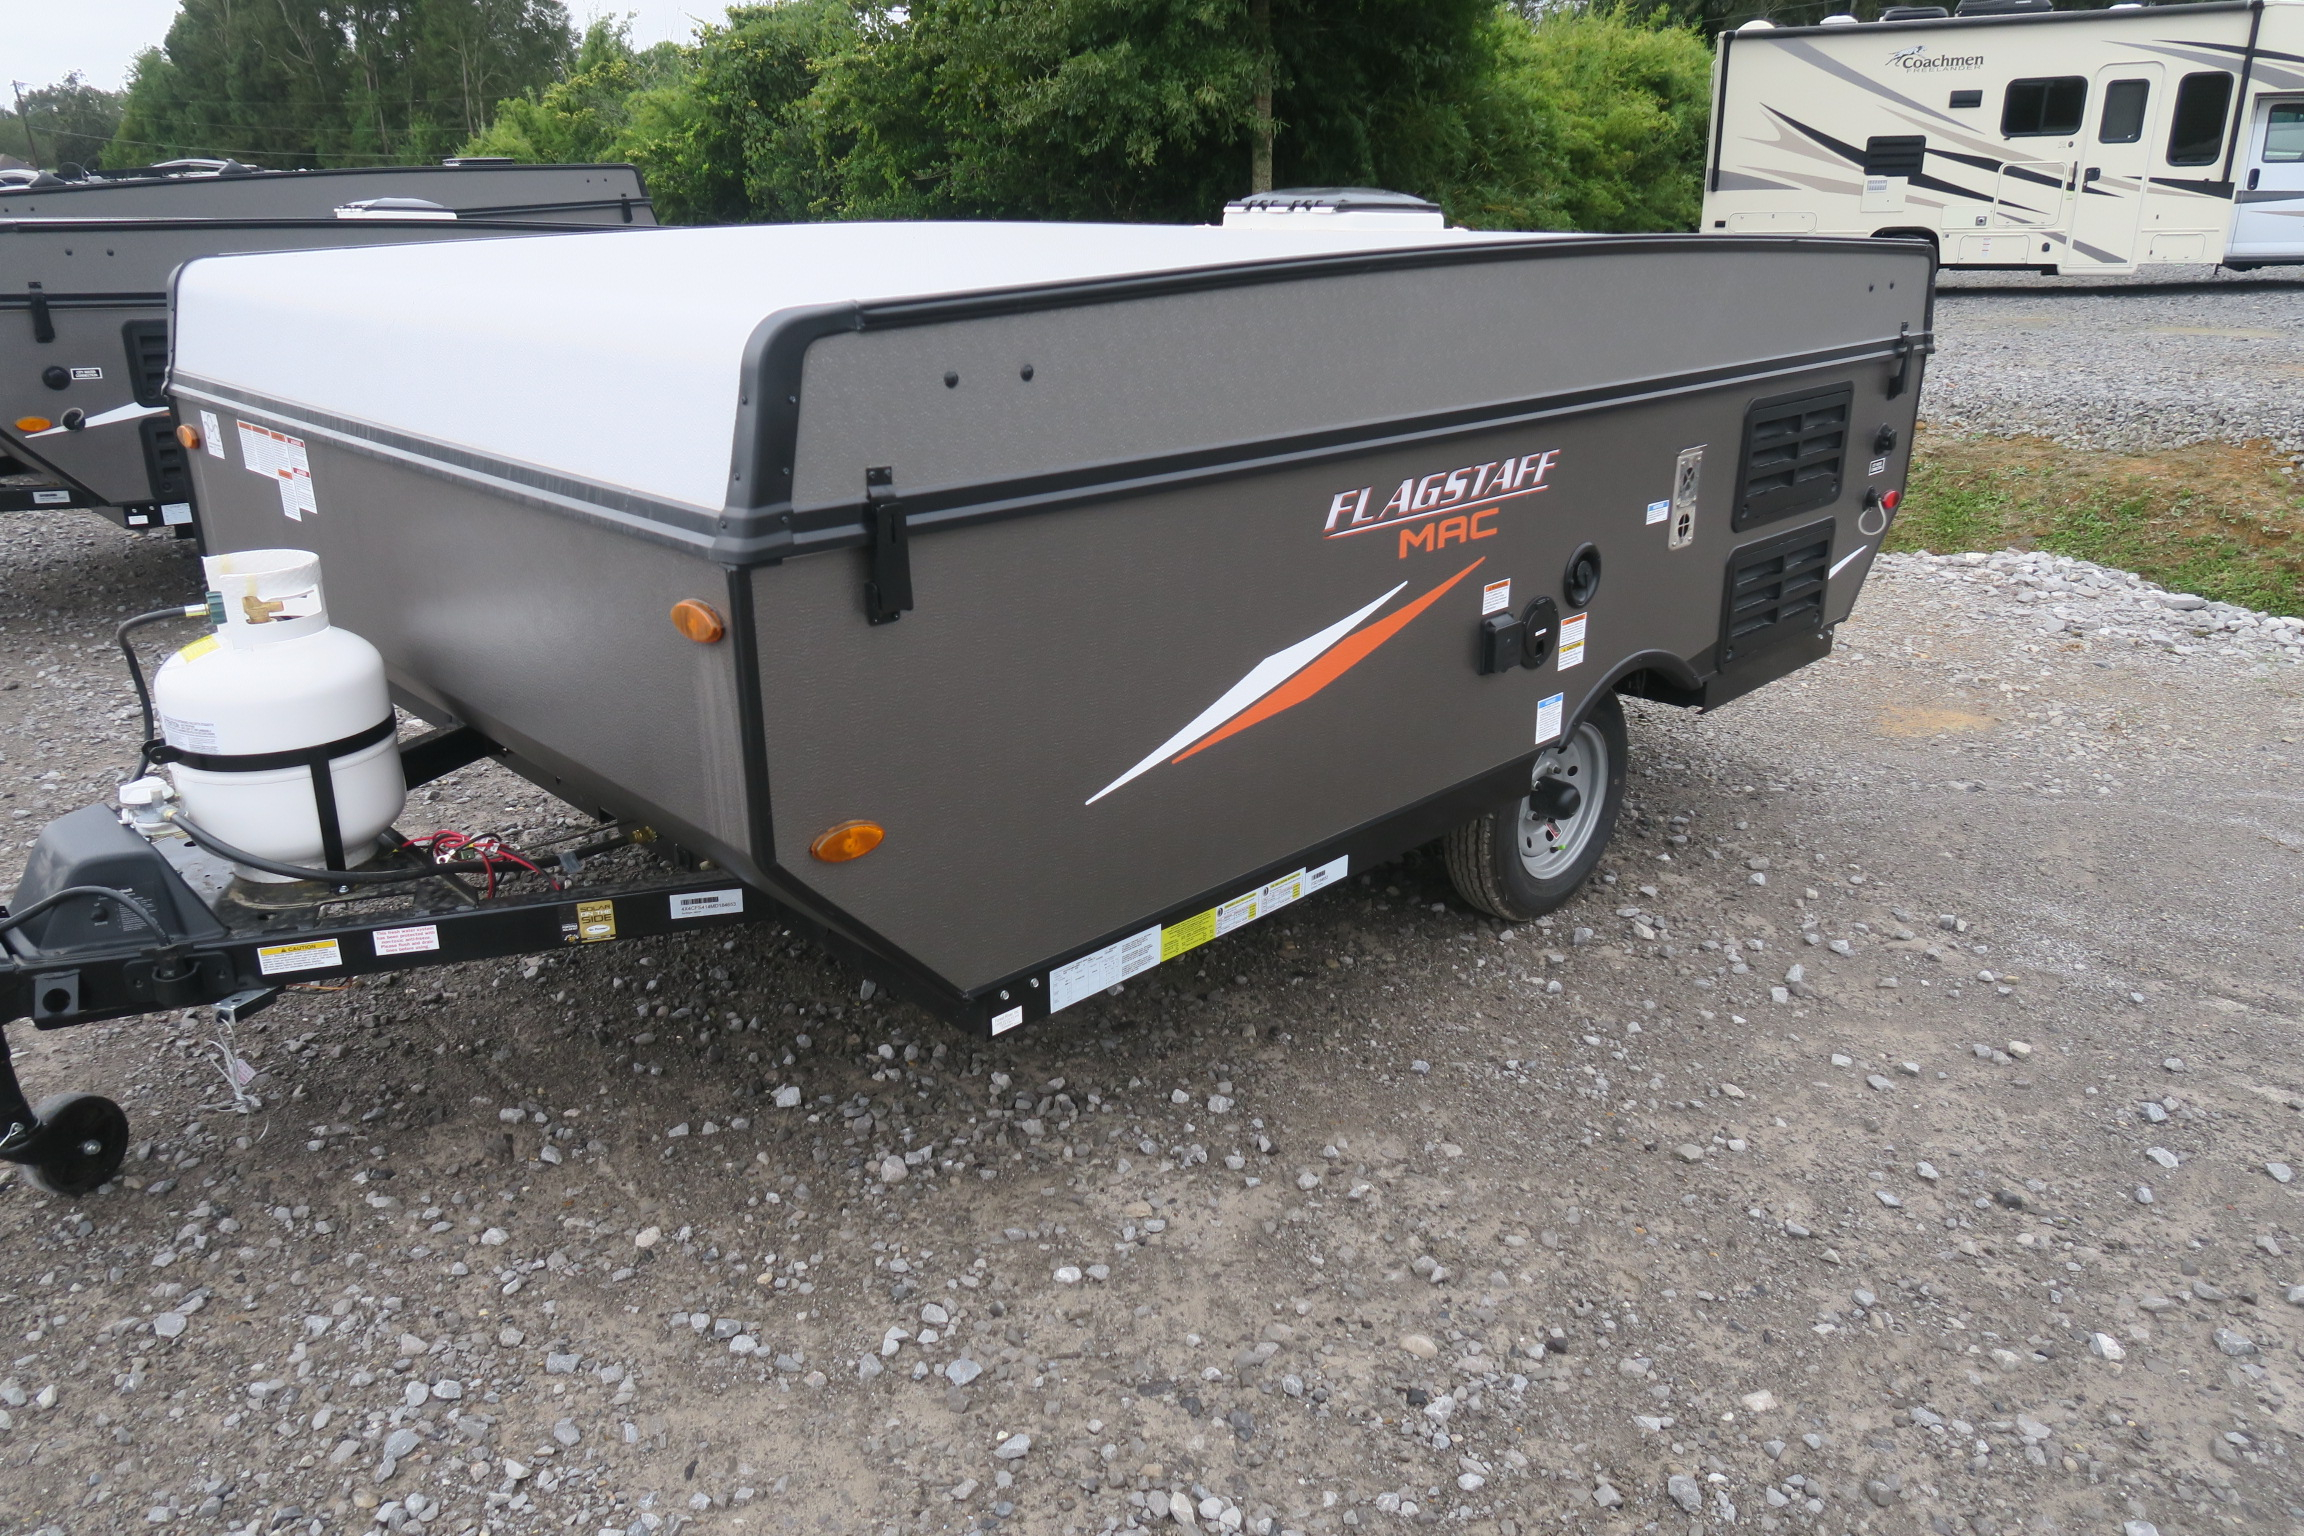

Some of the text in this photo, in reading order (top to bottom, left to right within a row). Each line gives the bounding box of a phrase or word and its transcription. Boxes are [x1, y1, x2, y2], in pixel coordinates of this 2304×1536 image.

[1903, 54, 1984, 69] Coachmen
[1906, 65, 1981, 73] FREELANDER
[1323, 449, 1561, 533] FLAGSTAFF
[1399, 507, 1499, 559] MAC
[581, 914, 612, 924] SIDE
[288, 944, 316, 952] CAUTION
